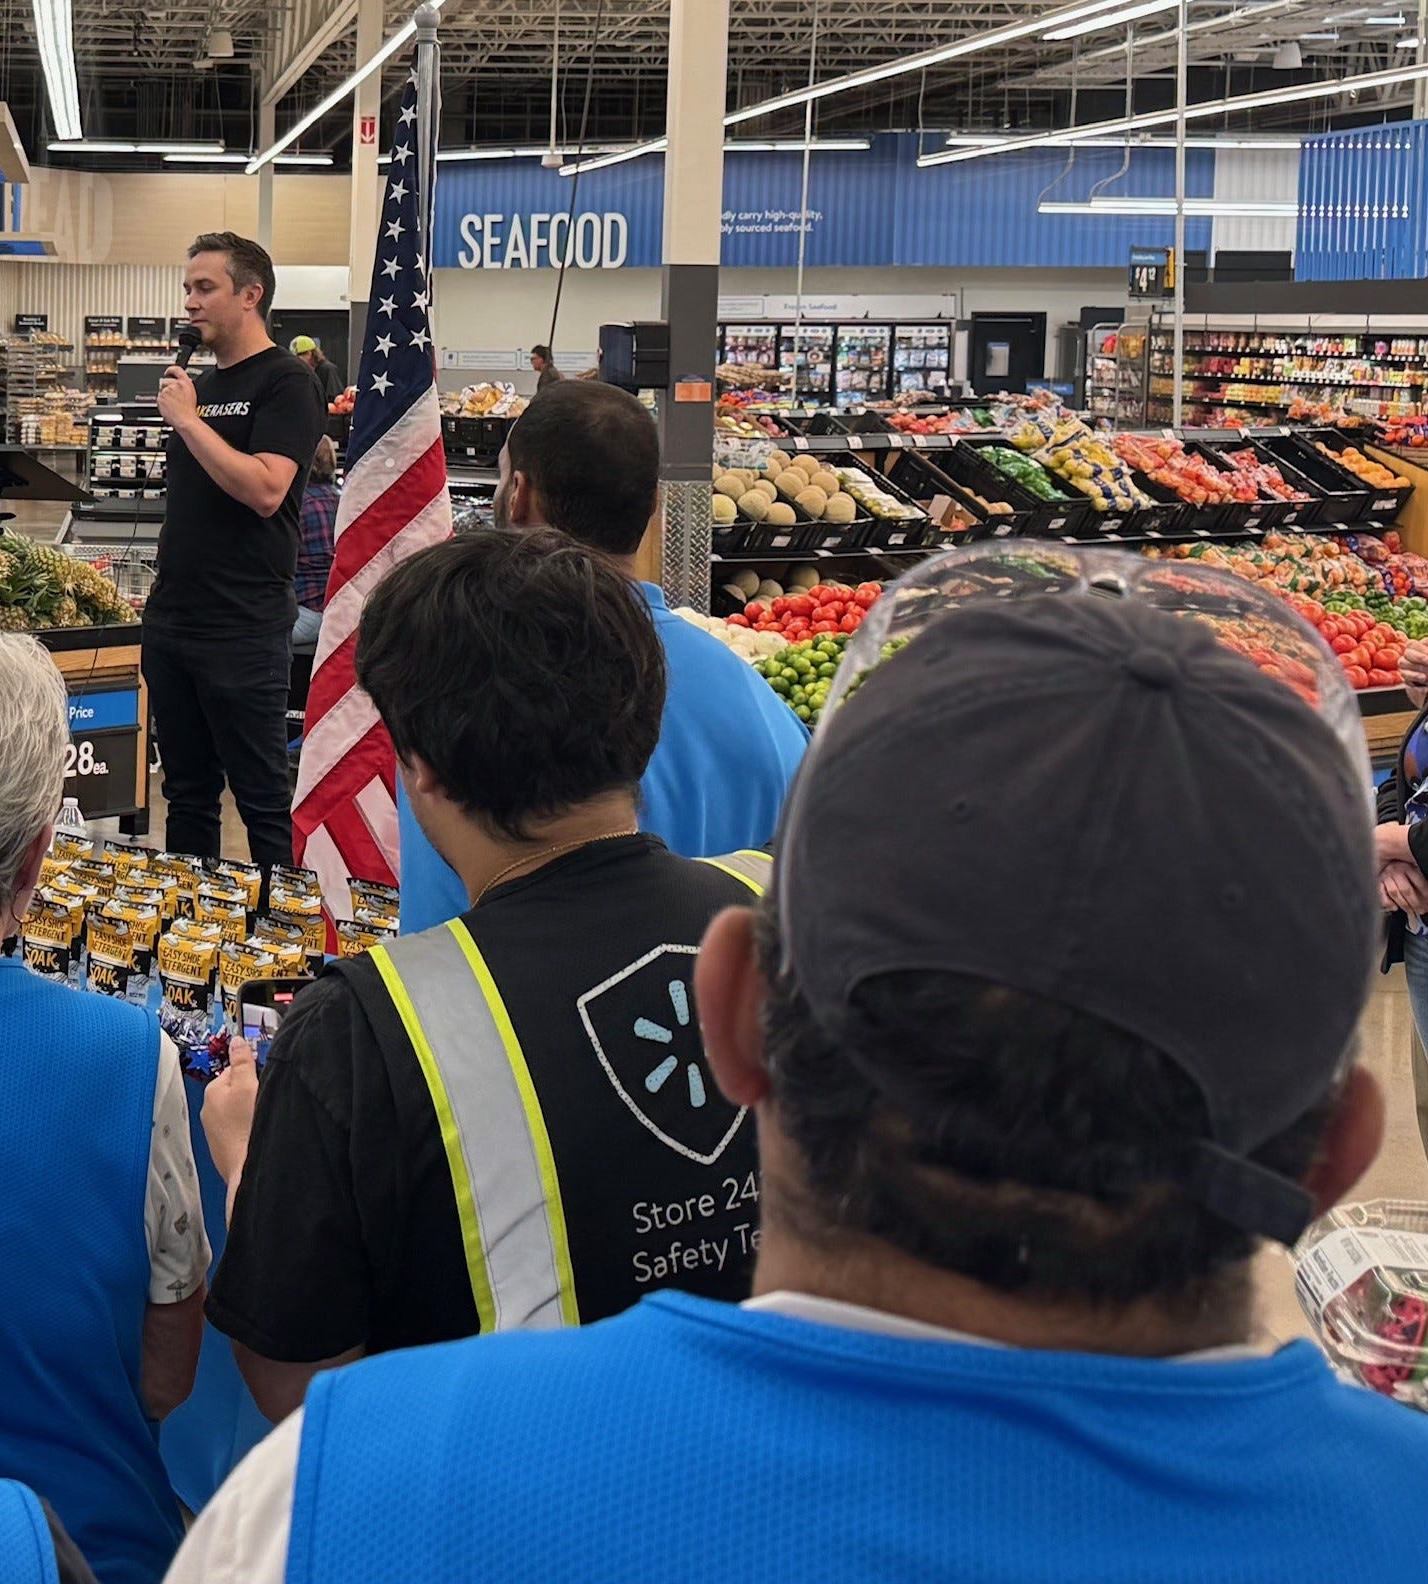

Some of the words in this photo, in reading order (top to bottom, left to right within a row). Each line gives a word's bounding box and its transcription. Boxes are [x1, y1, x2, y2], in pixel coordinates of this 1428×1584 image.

[738, 211, 762, 222] carry
[735, 222, 772, 233] sourced
[458, 212, 628, 269] SEAFOOD
[69, 706, 94, 720] Price
[163, 946, 182, 961] EASY
[182, 950, 202, 965] SHOE
[633, 1193, 715, 1234] Store
[722, 1171, 761, 1210] 24
[633, 1238, 728, 1283] Safety
[738, 1223, 761, 1255] Te
